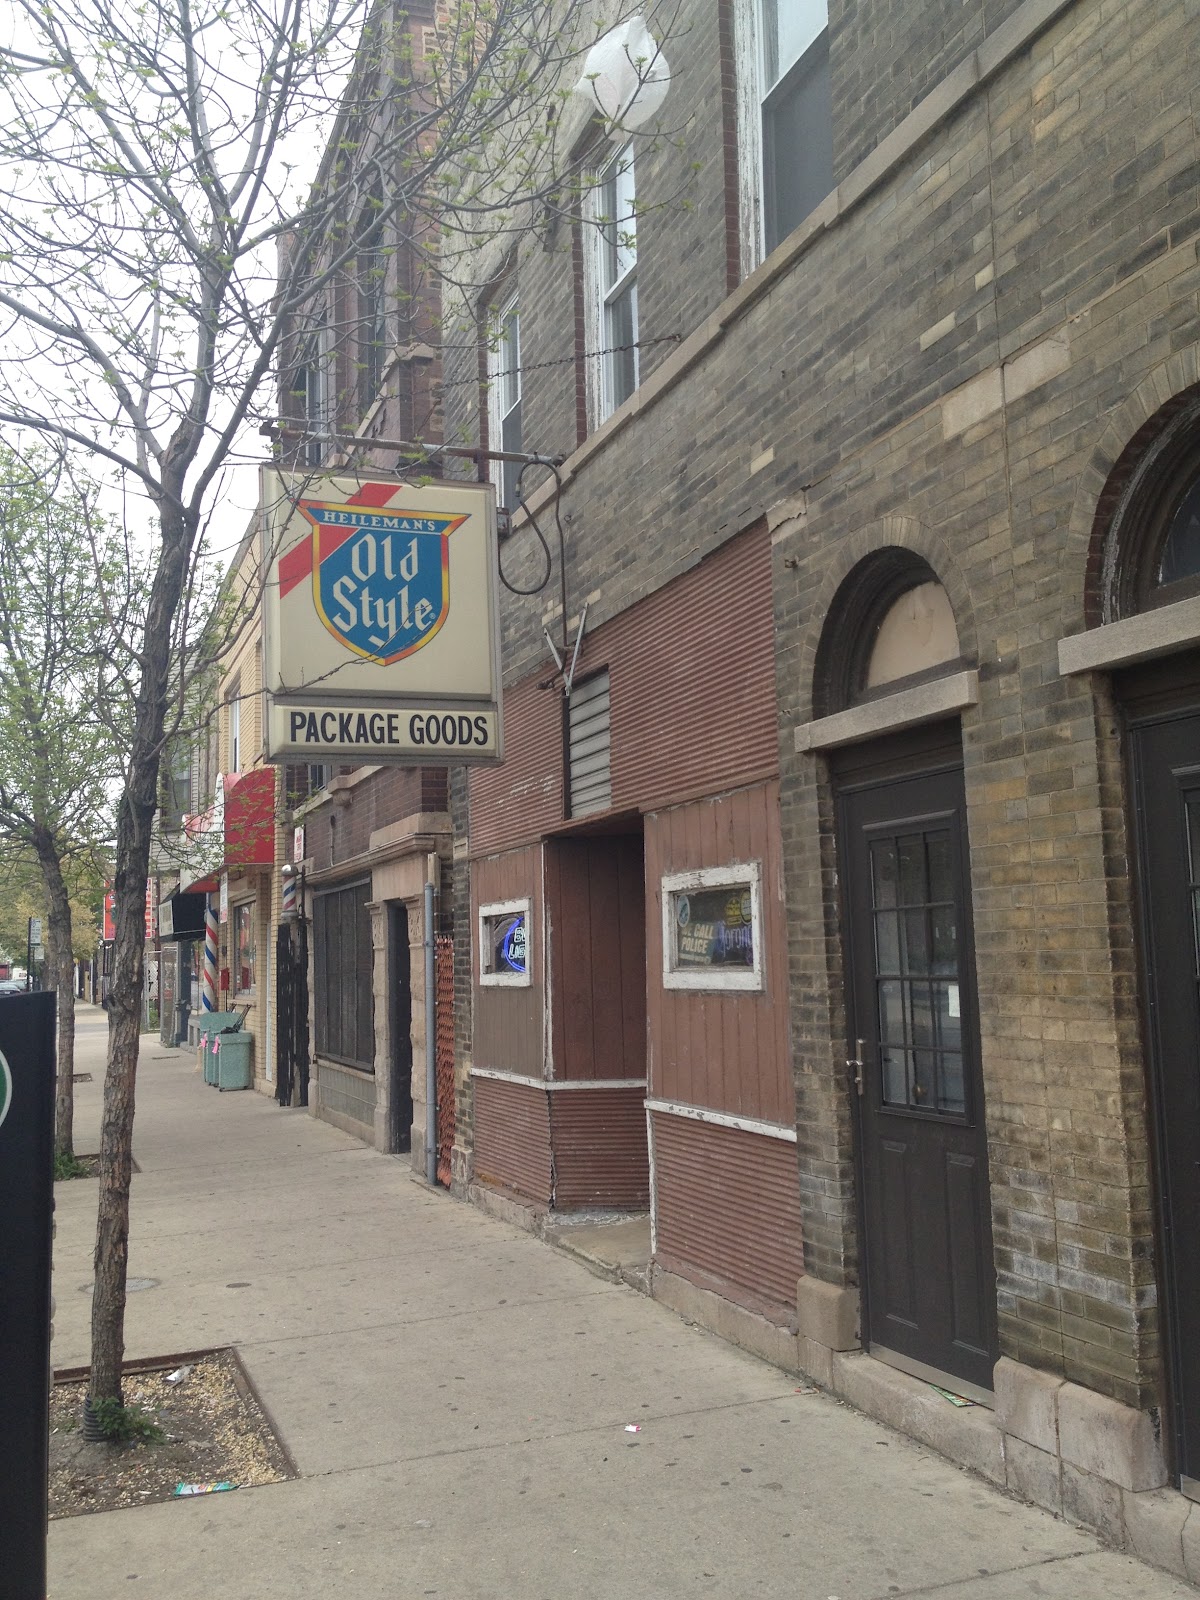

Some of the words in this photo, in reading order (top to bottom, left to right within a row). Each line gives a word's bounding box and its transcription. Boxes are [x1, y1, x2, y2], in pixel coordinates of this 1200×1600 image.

[322, 510, 436, 532] HEILEMAN'S
[351, 533, 418, 582] Old
[332, 575, 433, 648] Style
[290, 711, 400, 744] PACKAGE
[409, 714, 489, 746] GOODS
[681, 936, 709, 954] POLICE
